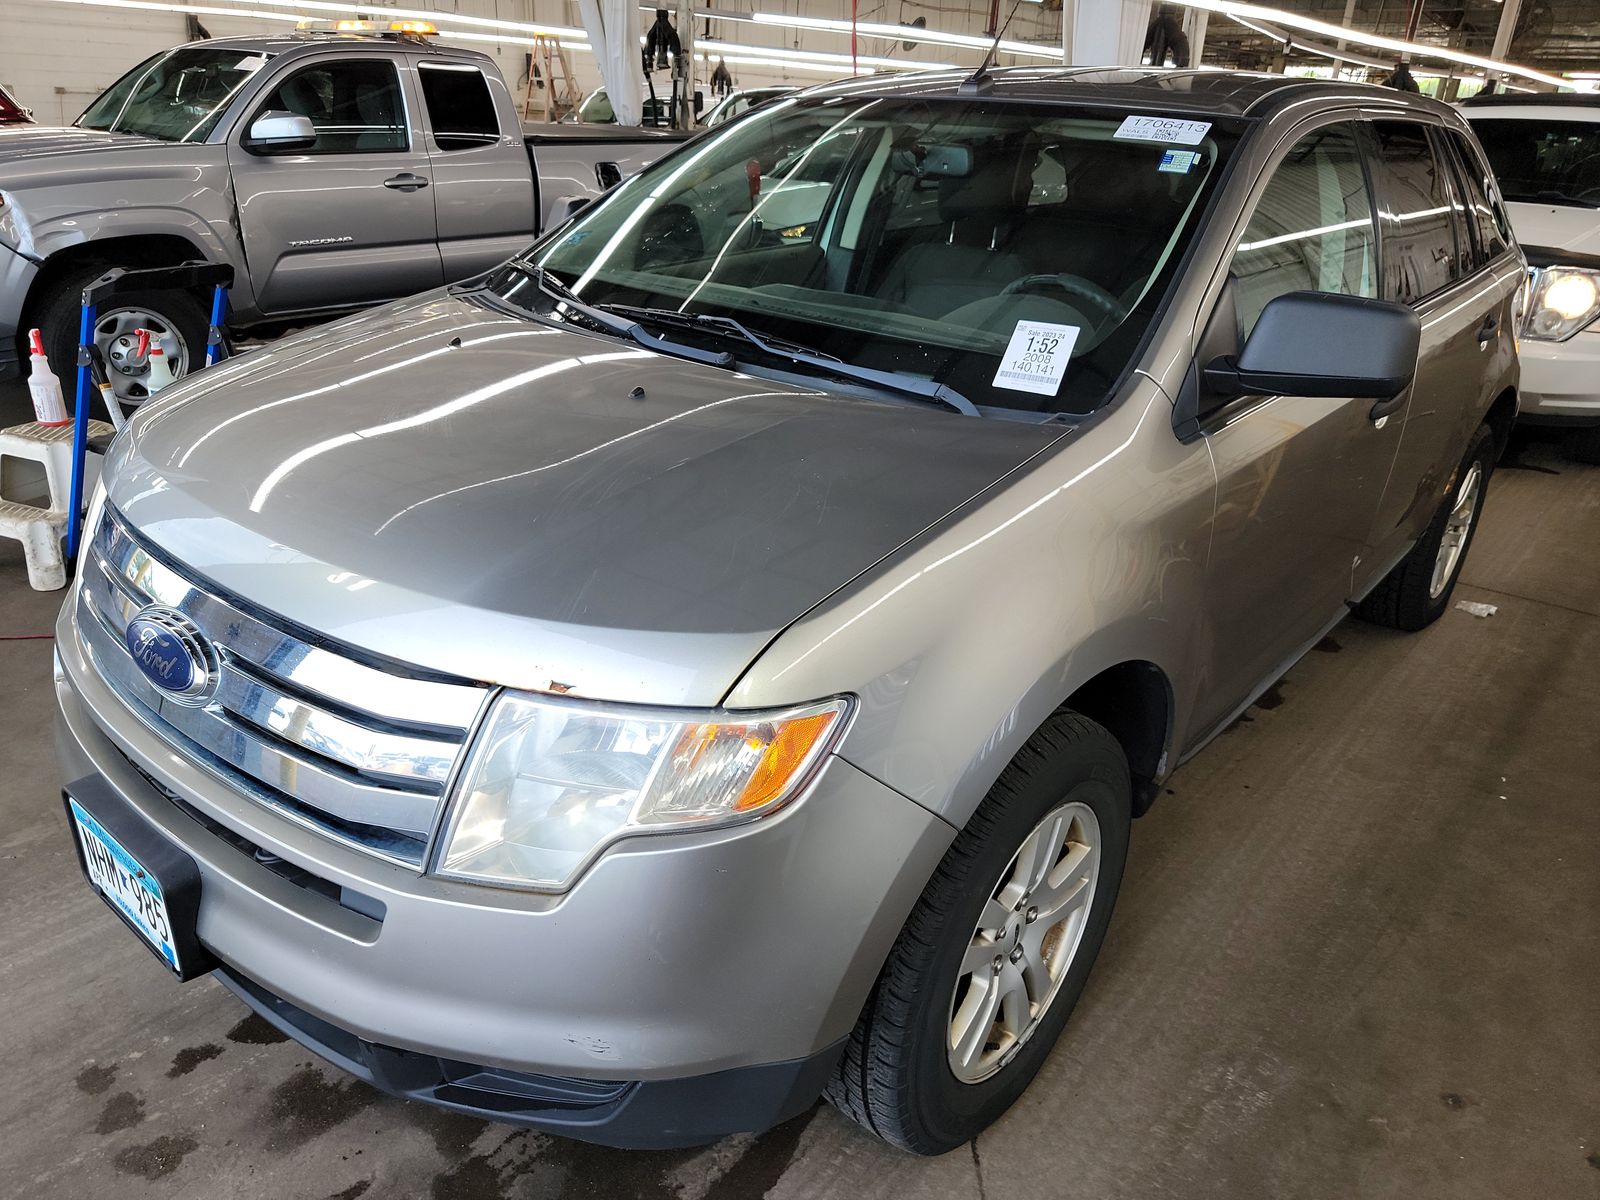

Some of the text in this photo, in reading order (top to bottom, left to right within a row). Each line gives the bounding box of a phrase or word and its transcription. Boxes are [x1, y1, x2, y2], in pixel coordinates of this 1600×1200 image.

[1133, 118, 1207, 133] 1706413
[287, 236, 354, 247] TACOMA
[1027, 336, 1059, 355] 1:52
[1023, 352, 1052, 365] 2008
[133, 627, 178, 680] Ford
[81, 825, 169, 943] NHM 985
